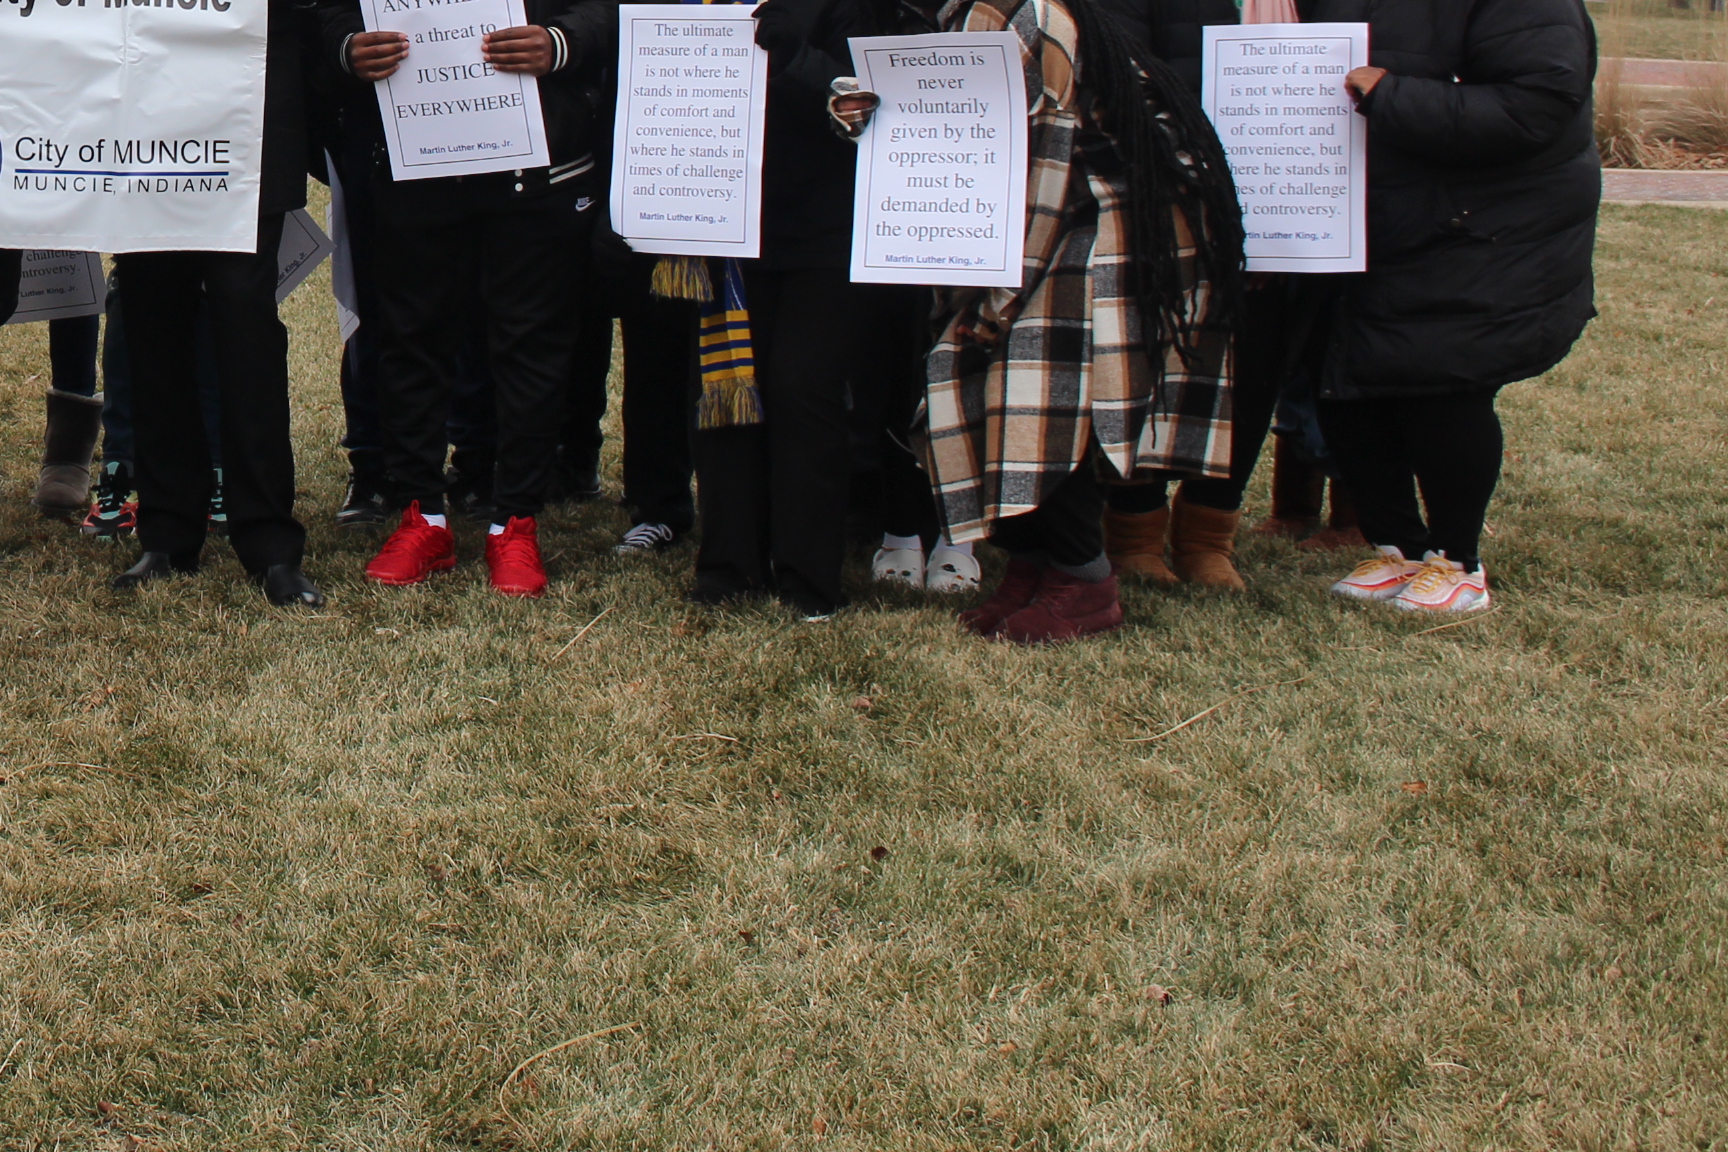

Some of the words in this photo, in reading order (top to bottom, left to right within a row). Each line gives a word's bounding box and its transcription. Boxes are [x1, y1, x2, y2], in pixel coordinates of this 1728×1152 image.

[416, 32, 424, 43] a
[429, 26, 475, 42] threat
[480, 23, 496, 35] to
[654, 24, 678, 36] The
[683, 23, 733, 37] ultimate
[639, 46, 690, 56] measure
[694, 43, 707, 56] of
[711, 47, 718, 56] a
[722, 47, 748, 57] man
[1240, 43, 1264, 55] The
[1270, 43, 1326, 55] ultimate
[889, 52, 965, 67] Freedom
[970, 52, 984, 66] is
[418, 61, 495, 84] JUSTICE
[645, 65, 655, 77] is
[660, 67, 679, 78] not
[684, 66, 721, 78] where
[725, 65, 739, 78] he
[1223, 65, 1278, 76] measure
[1282, 62, 1298, 75] of
[1302, 65, 1309, 74] a
[1314, 64, 1344, 75] man
[918, 77, 964, 89] never
[1230, 85, 1241, 96] is
[1245, 85, 1266, 96] not
[1272, 83, 1314, 96] where
[1319, 85, 1335, 96] he
[634, 86, 672, 97] stands
[676, 86, 687, 97] in
[692, 87, 748, 98] moments
[396, 93, 523, 118] EVERYWHERE
[644, 105, 658, 116] of
[660, 105, 709, 117] comfort
[713, 106, 735, 117] and
[898, 98, 989, 117] voluntarily
[1219, 104, 1260, 116] stands
[1265, 104, 1278, 116] in
[1283, 105, 1347, 116] moments
[636, 125, 716, 138] convenience,
[721, 125, 740, 138] but
[890, 123, 938, 142] given
[944, 124, 964, 142] by
[970, 124, 996, 138] the
[1231, 124, 1246, 135] of
[1249, 124, 1304, 135] comfort
[1309, 124, 1334, 135] and
[15, 137, 68, 168] City
[78, 139, 106, 162] of
[114, 140, 230, 165] MUNCIE
[631, 145, 667, 156] where
[671, 145, 685, 157] he
[689, 146, 728, 158] stands
[732, 146, 744, 158] in
[1225, 143, 1315, 157] convenience,
[1320, 144, 1342, 155] but
[889, 151, 977, 167] oppressor;
[984, 149, 995, 164] it
[629, 164, 662, 176] times
[666, 164, 680, 176] of
[683, 165, 743, 181] challenge
[1230, 163, 1259, 175] here
[1264, 163, 1281, 175] he
[1285, 163, 1330, 175] stands
[1335, 163, 1347, 175] in
[14, 176, 117, 195] MUNCIE,
[128, 177, 229, 193] INDIANA
[907, 175, 950, 188] must
[955, 173, 974, 188] be
[633, 184, 655, 196] and
[659, 186, 736, 201] controversy.
[1260, 183, 1275, 194] of
[1279, 183, 1347, 198] challenge
[881, 197, 969, 213] demanded
[976, 199, 997, 217] by
[1253, 204, 1340, 218] controversy.
[876, 222, 901, 236] the
[907, 224, 999, 241] oppressed.
